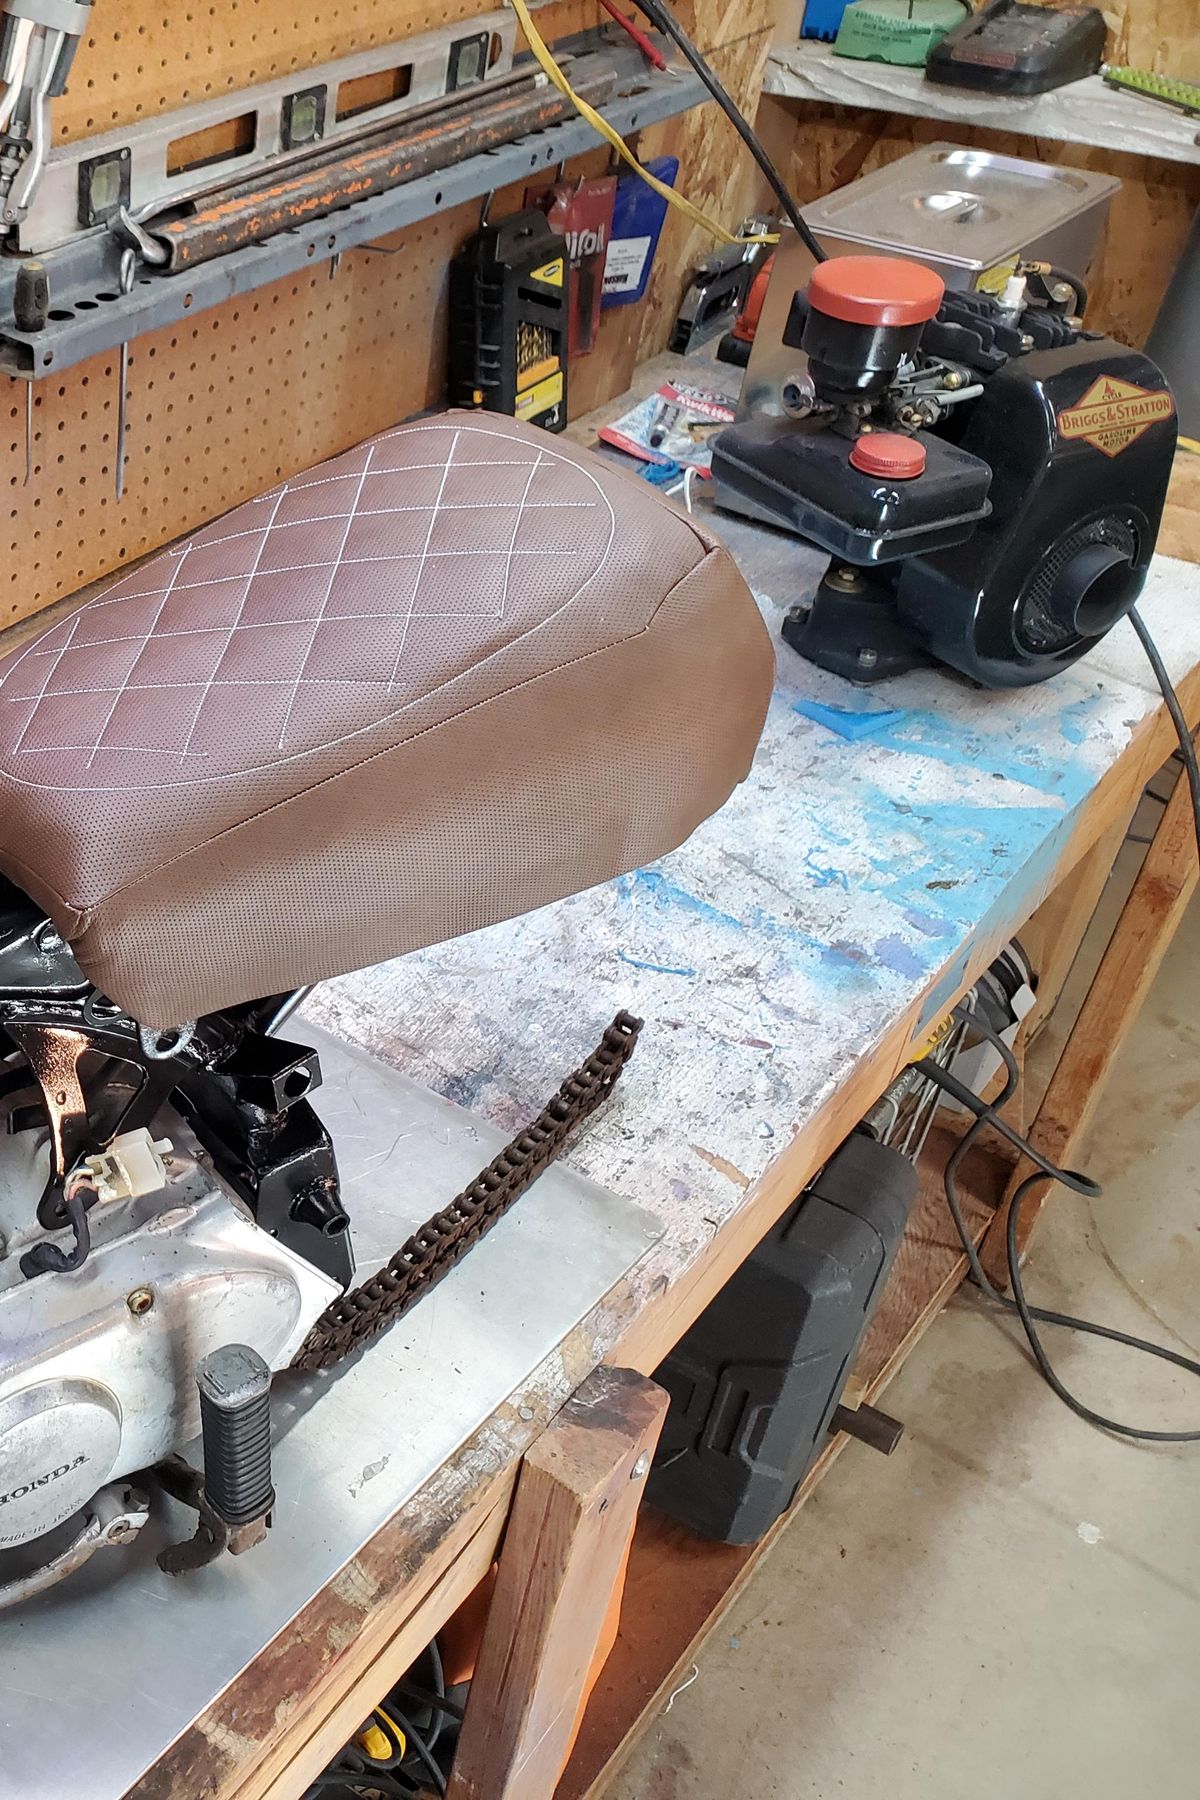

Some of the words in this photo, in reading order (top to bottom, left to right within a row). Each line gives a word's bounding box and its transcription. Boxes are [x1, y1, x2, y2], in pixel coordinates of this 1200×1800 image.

[1098, 427, 1137, 441] GASOLINE
[1103, 436, 1130, 448] MOTOR
[0, 1531, 27, 1543] MADE
[33, 1523, 46, 1534] IN
[53, 1497, 84, 1522] JAPAN
